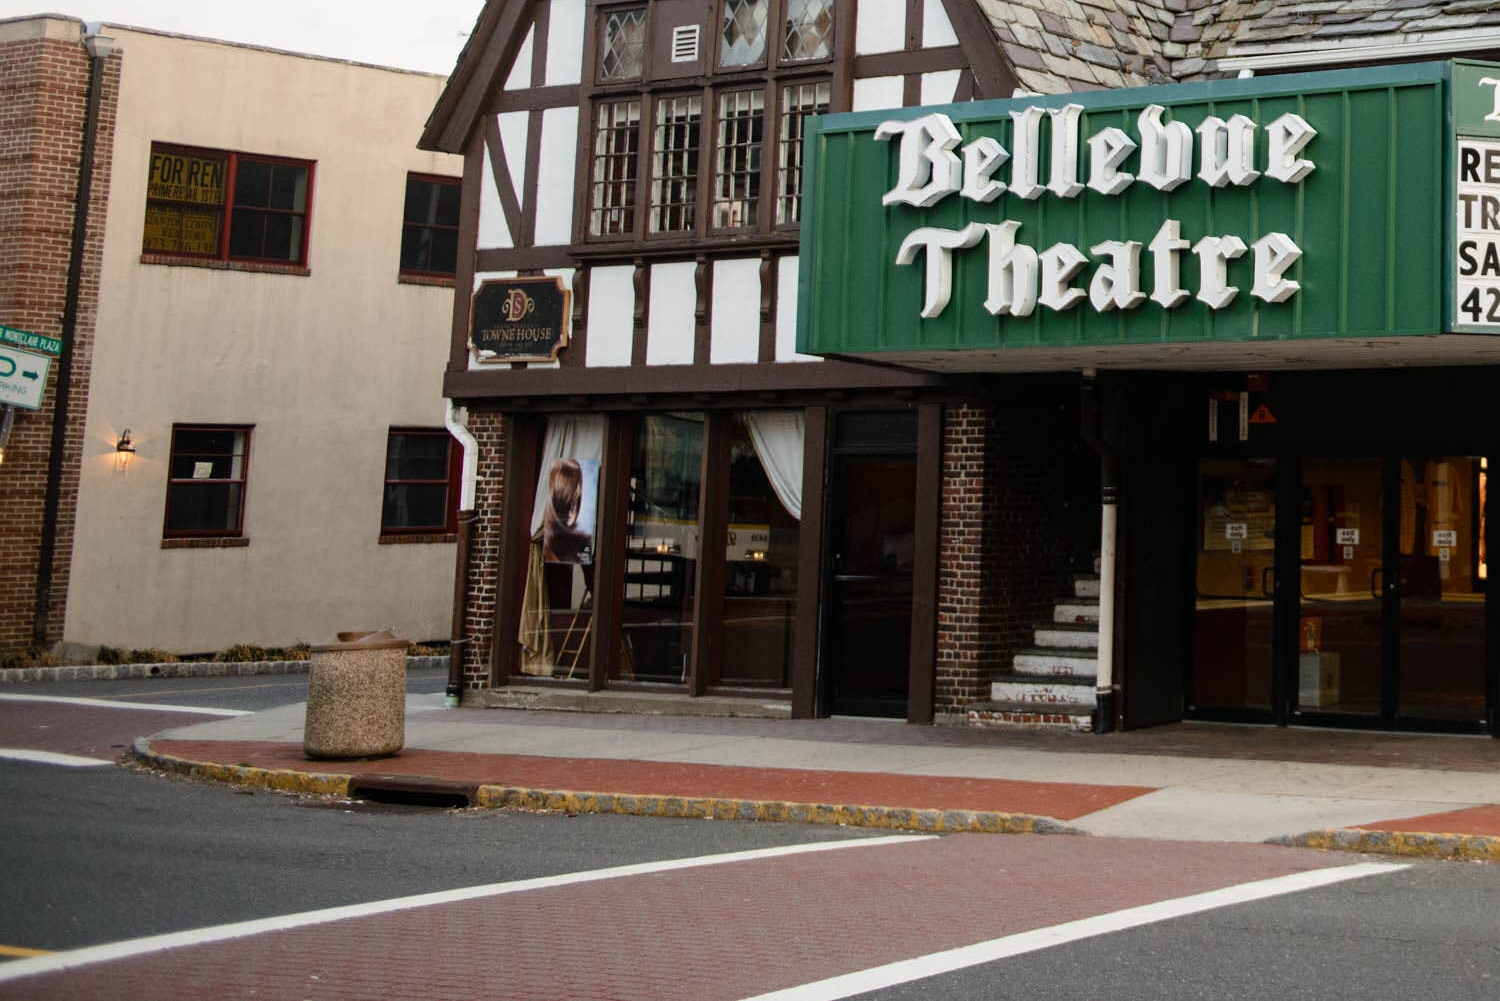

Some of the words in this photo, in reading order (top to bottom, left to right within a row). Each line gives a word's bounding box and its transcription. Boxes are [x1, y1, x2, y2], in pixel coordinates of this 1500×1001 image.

[151, 155, 184, 185] FOR
[188, 159, 225, 189] REN
[873, 103, 1318, 207] Bellevue
[895, 218, 1303, 318] Theatre
[5, 328, 39, 348] MONTCLAIR
[40, 337, 60, 352] PLAZA
[481, 328, 515, 342] TOWNE
[517, 327, 552, 342] HOUSE
